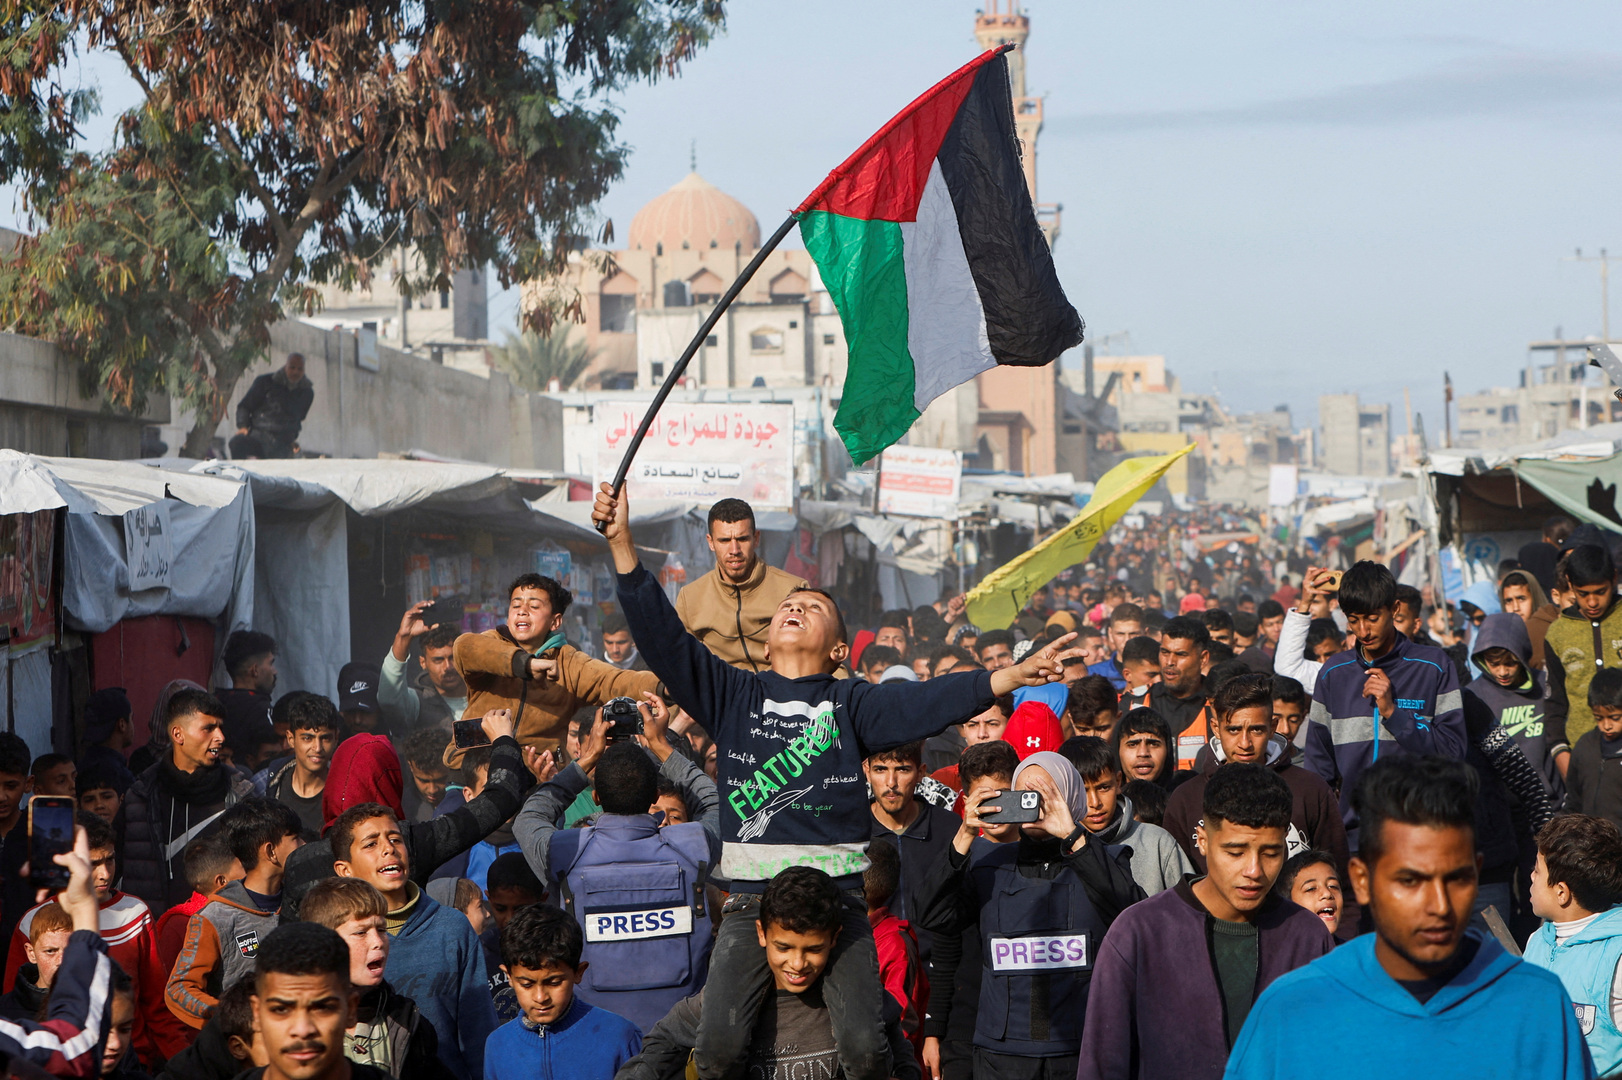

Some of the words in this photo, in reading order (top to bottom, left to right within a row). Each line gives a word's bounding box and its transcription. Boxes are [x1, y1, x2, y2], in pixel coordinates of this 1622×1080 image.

[606, 410, 661, 449] الالي
[667, 411, 728, 446] للمزاج
[734, 411, 779, 449] جودة
[643, 465, 698, 478] السعادة
[702, 467, 740, 482] صانع
[1395, 698, 1426, 710] URRENT
[1500, 704, 1536, 726] NIKE
[1524, 722, 1544, 738] SB
[727, 711, 840, 820] FEATURED
[790, 801, 801, 810] to
[803, 802, 813, 811] be
[813, 804, 834, 818] year
[597, 910, 675, 935] PRESS
[995, 938, 1084, 965] PRESS
